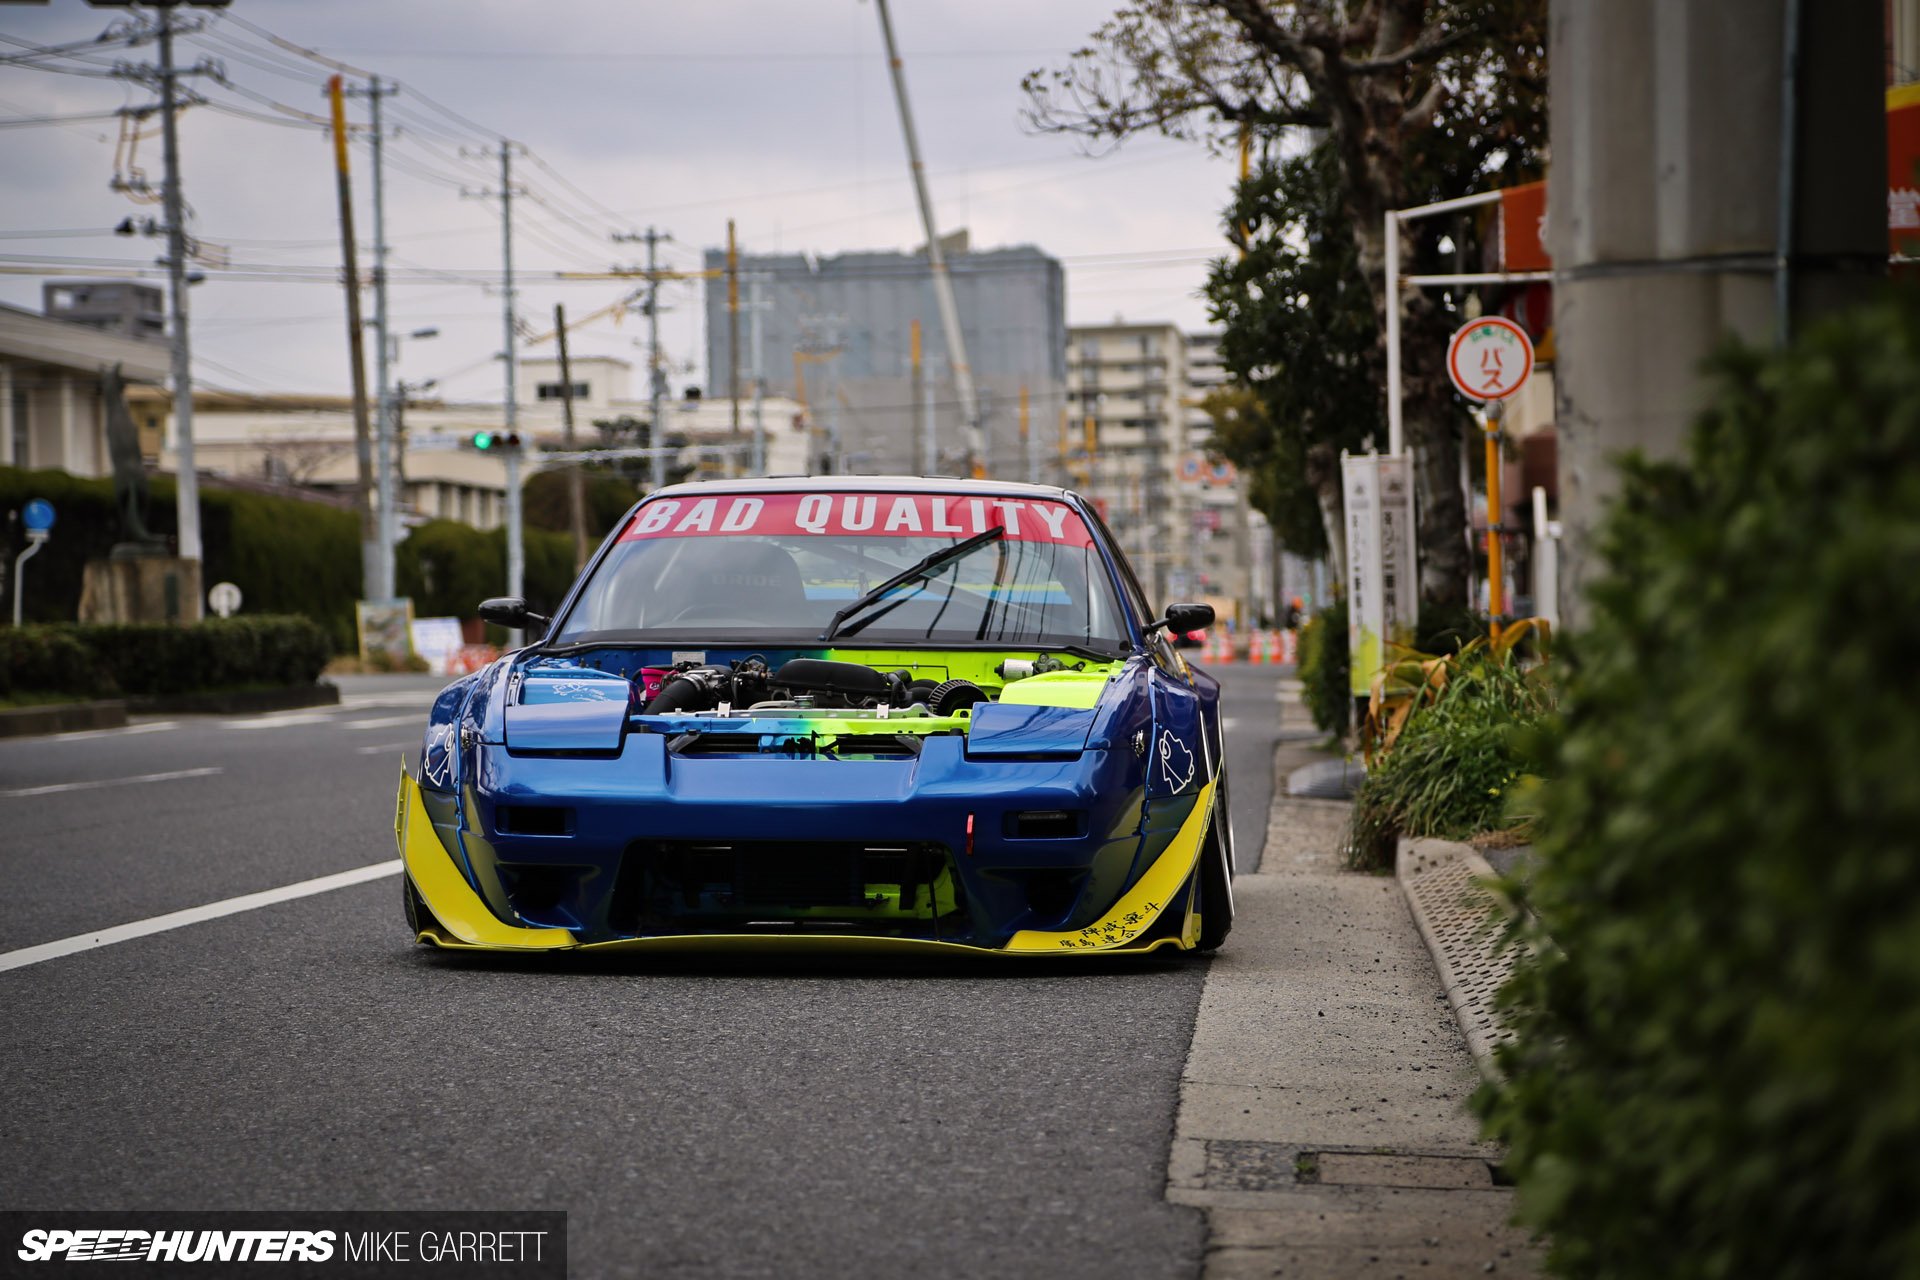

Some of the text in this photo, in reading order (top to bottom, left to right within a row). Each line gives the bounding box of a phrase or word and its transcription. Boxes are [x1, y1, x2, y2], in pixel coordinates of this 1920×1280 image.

[1481, 346, 1505, 390] バス
[632, 493, 1068, 539] BAD QUALITY
